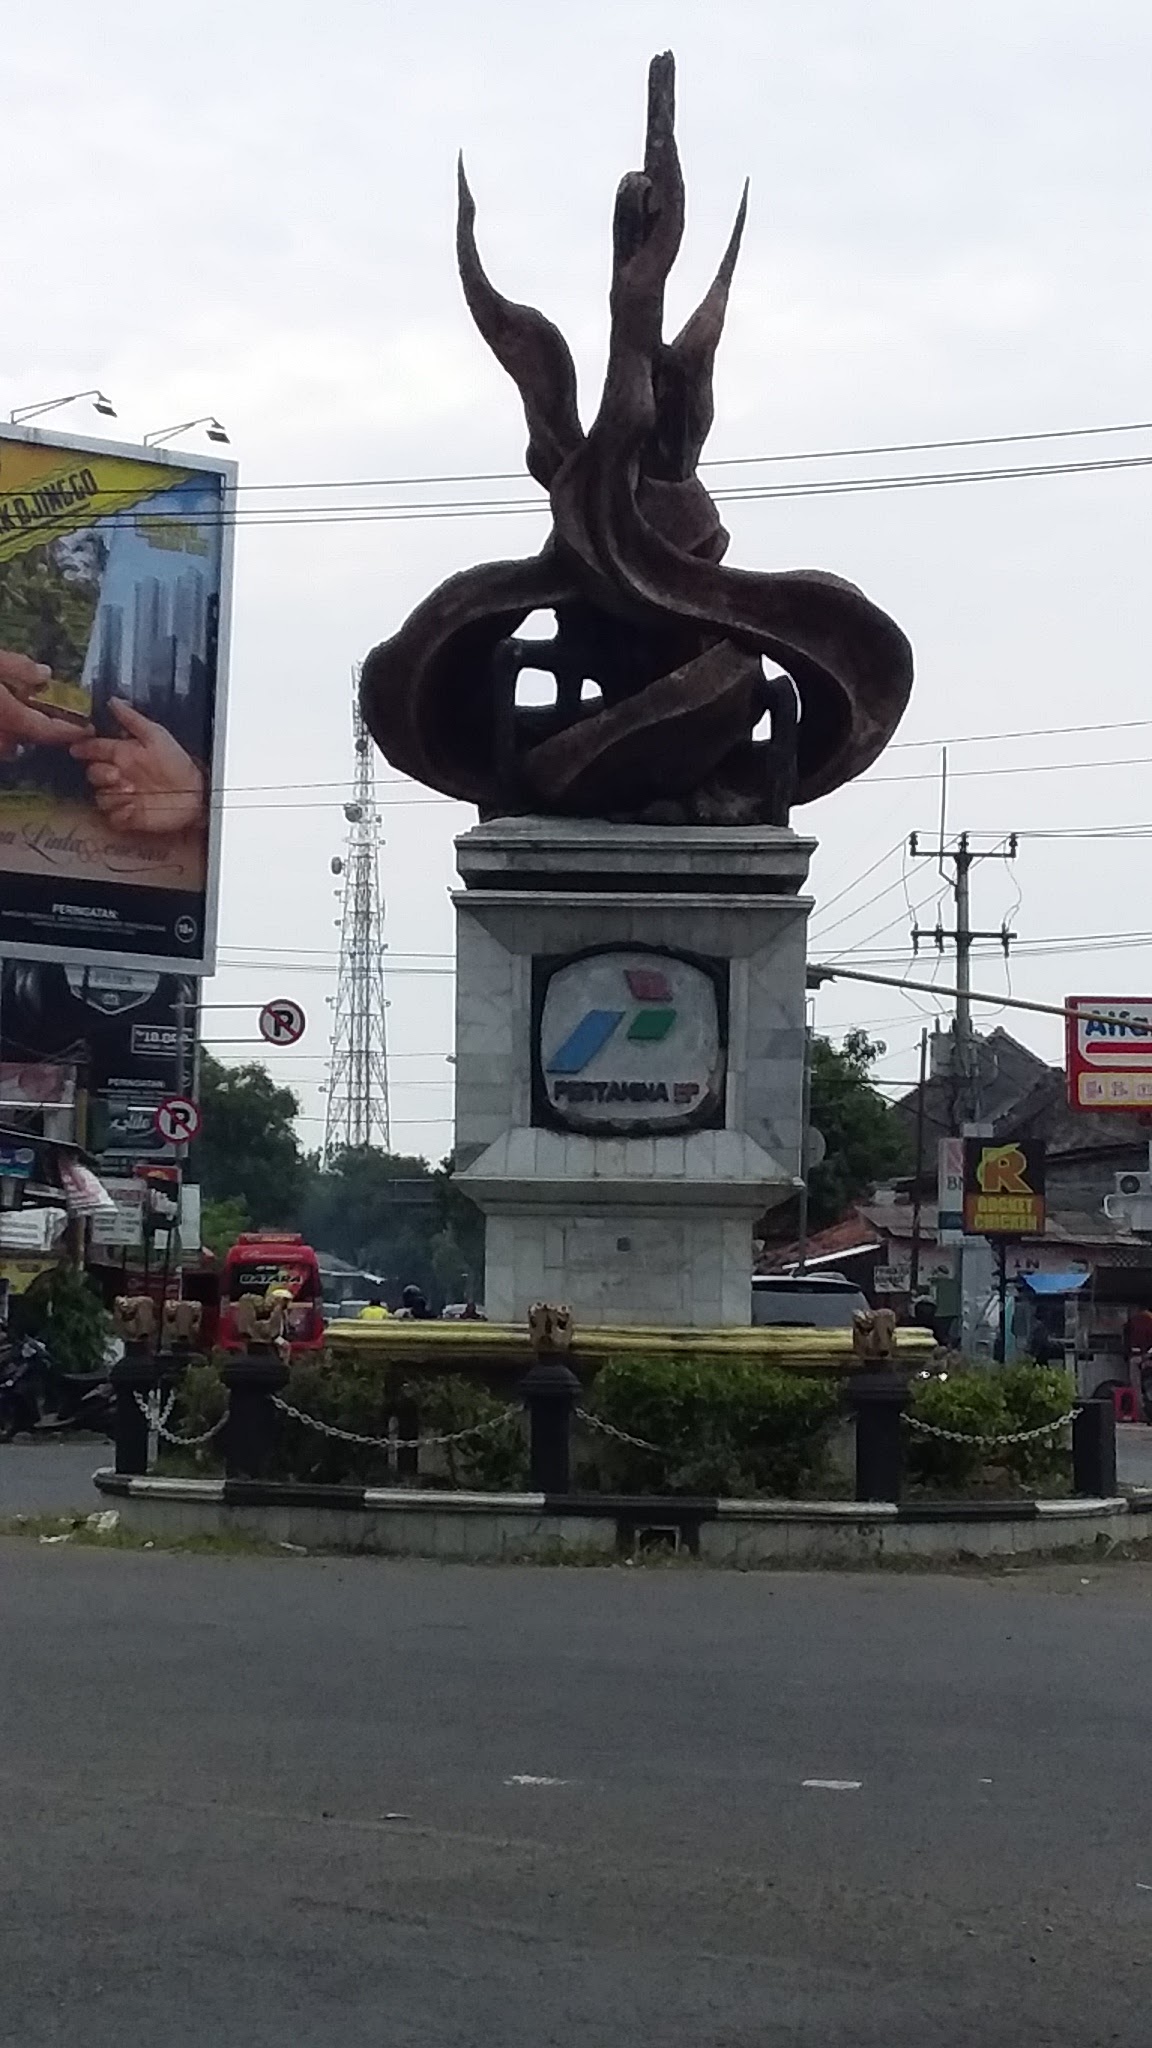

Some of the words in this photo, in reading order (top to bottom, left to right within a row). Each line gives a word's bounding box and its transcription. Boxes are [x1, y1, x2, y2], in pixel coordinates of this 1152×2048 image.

[554, 1080, 670, 1102] PERTAMINA
[674, 1082, 699, 1103] EP
[974, 1214, 1037, 1230] CHICKEN
